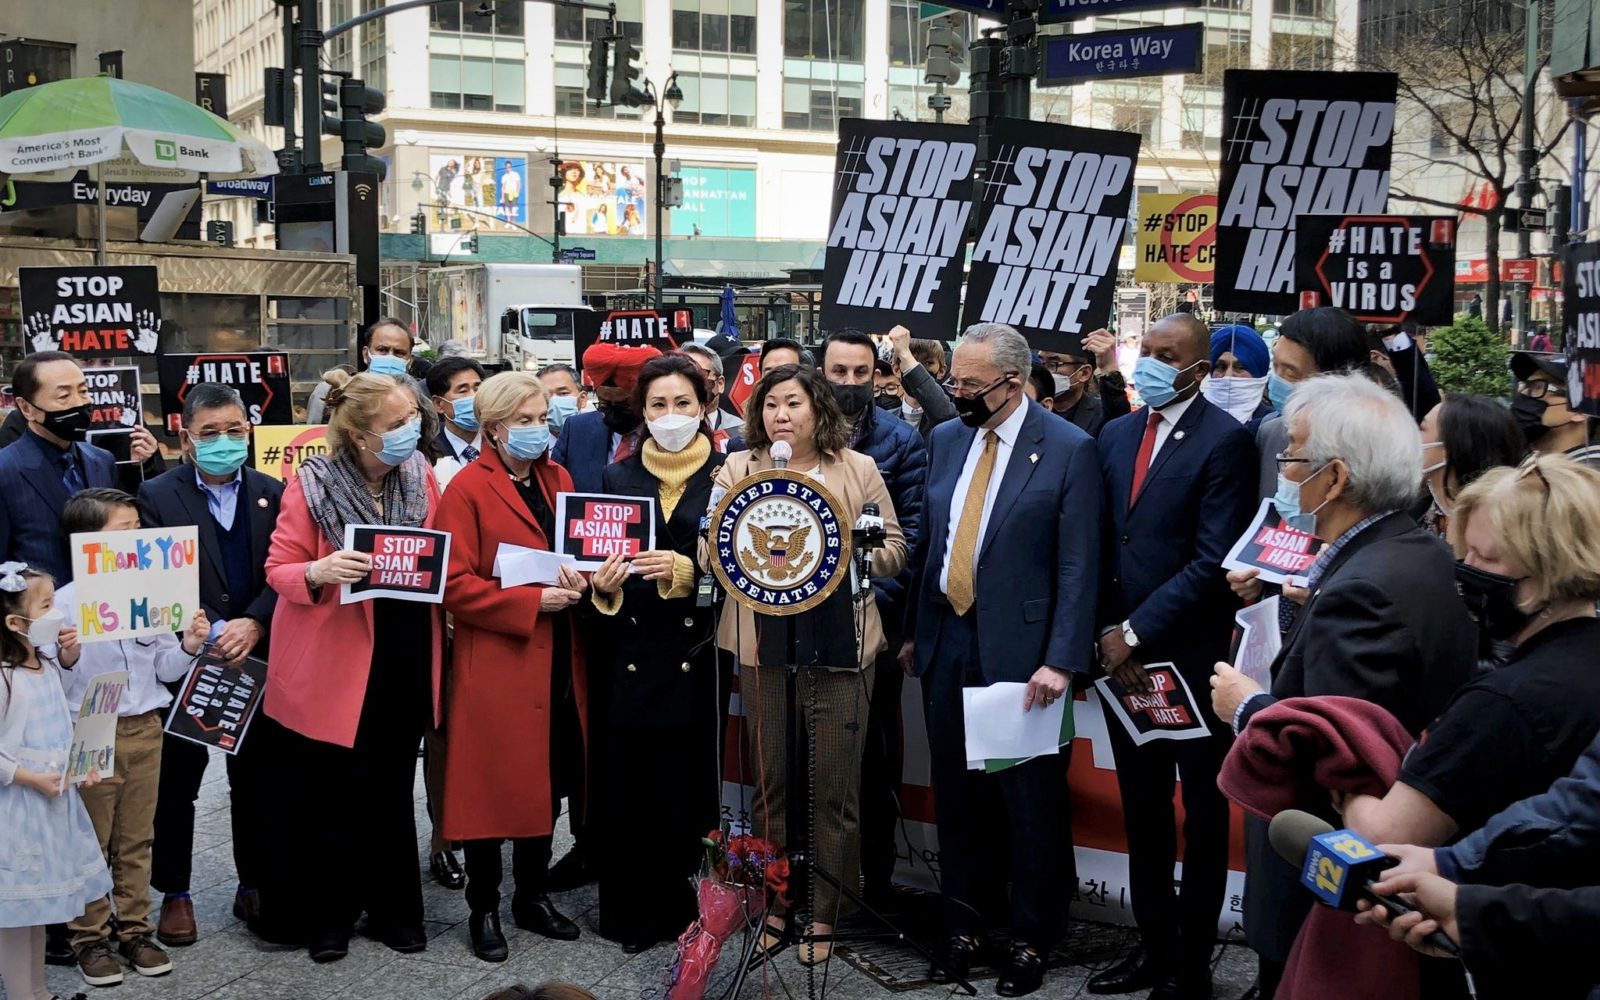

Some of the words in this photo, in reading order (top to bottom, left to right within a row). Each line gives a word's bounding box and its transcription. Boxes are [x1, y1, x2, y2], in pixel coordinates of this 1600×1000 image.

[1069, 40, 1123, 62] Korea
[1130, 36, 1173, 59] Way
[1227, 98, 1395, 168] #STOP
[11, 151, 74, 166] Convenient
[78, 147, 104, 159] Bank
[17, 140, 70, 154] America's
[73, 137, 101, 147] Most
[179, 146, 210, 158] Bank
[837, 135, 977, 198] #STOP
[309, 175, 333, 186] LinkNYC
[682, 176, 707, 186] HOP
[983, 144, 1132, 214] #STOP
[683, 190, 747, 201] ANHATTAN
[1219, 163, 1389, 230] ASIAN
[827, 192, 972, 258] ASIAN
[1144, 213, 1208, 232] #STOP
[972, 203, 1126, 276] ASIAN
[1328, 226, 1422, 256] #HATE
[1145, 244, 1190, 263] HATE
[1234, 229, 1296, 294] HA
[1347, 257, 1368, 280] is
[1379, 261, 1393, 280] a
[1576, 260, 1600, 299] STO
[57, 276, 124, 297] STOP
[836, 250, 948, 313] HATE
[980, 265, 1100, 334] HATE
[1330, 281, 1416, 312] VIRUS
[52, 302, 133, 324] ASIAN
[600, 317, 668, 340] #HATE
[1577, 312, 1600, 348] ASI
[63, 329, 129, 351] HATE
[84, 374, 119, 388] TOP
[186, 362, 262, 385] #HATE
[89, 390, 125, 405] IAN
[91, 406, 122, 422] ATE
[593, 504, 633, 523] STOP
[719, 481, 773, 543] UNITED
[787, 483, 839, 547] STATES
[574, 521, 623, 539] ASIAN
[1260, 529, 1309, 552] ASIAN
[383, 537, 427, 555] STOP
[592, 538, 631, 556] HATE
[373, 554, 414, 572] SIAN
[1266, 548, 1308, 569] HATE
[380, 571, 423, 587] HATE
[736, 577, 818, 604] SENATE
[186, 664, 224, 718] VIRUS
[217, 679, 235, 694] is
[210, 698, 223, 708] a
[218, 673, 255, 731] #HATE
[1151, 708, 1184, 724] HATE
[1306, 849, 1322, 882] news
[1316, 857, 1343, 895] 12
